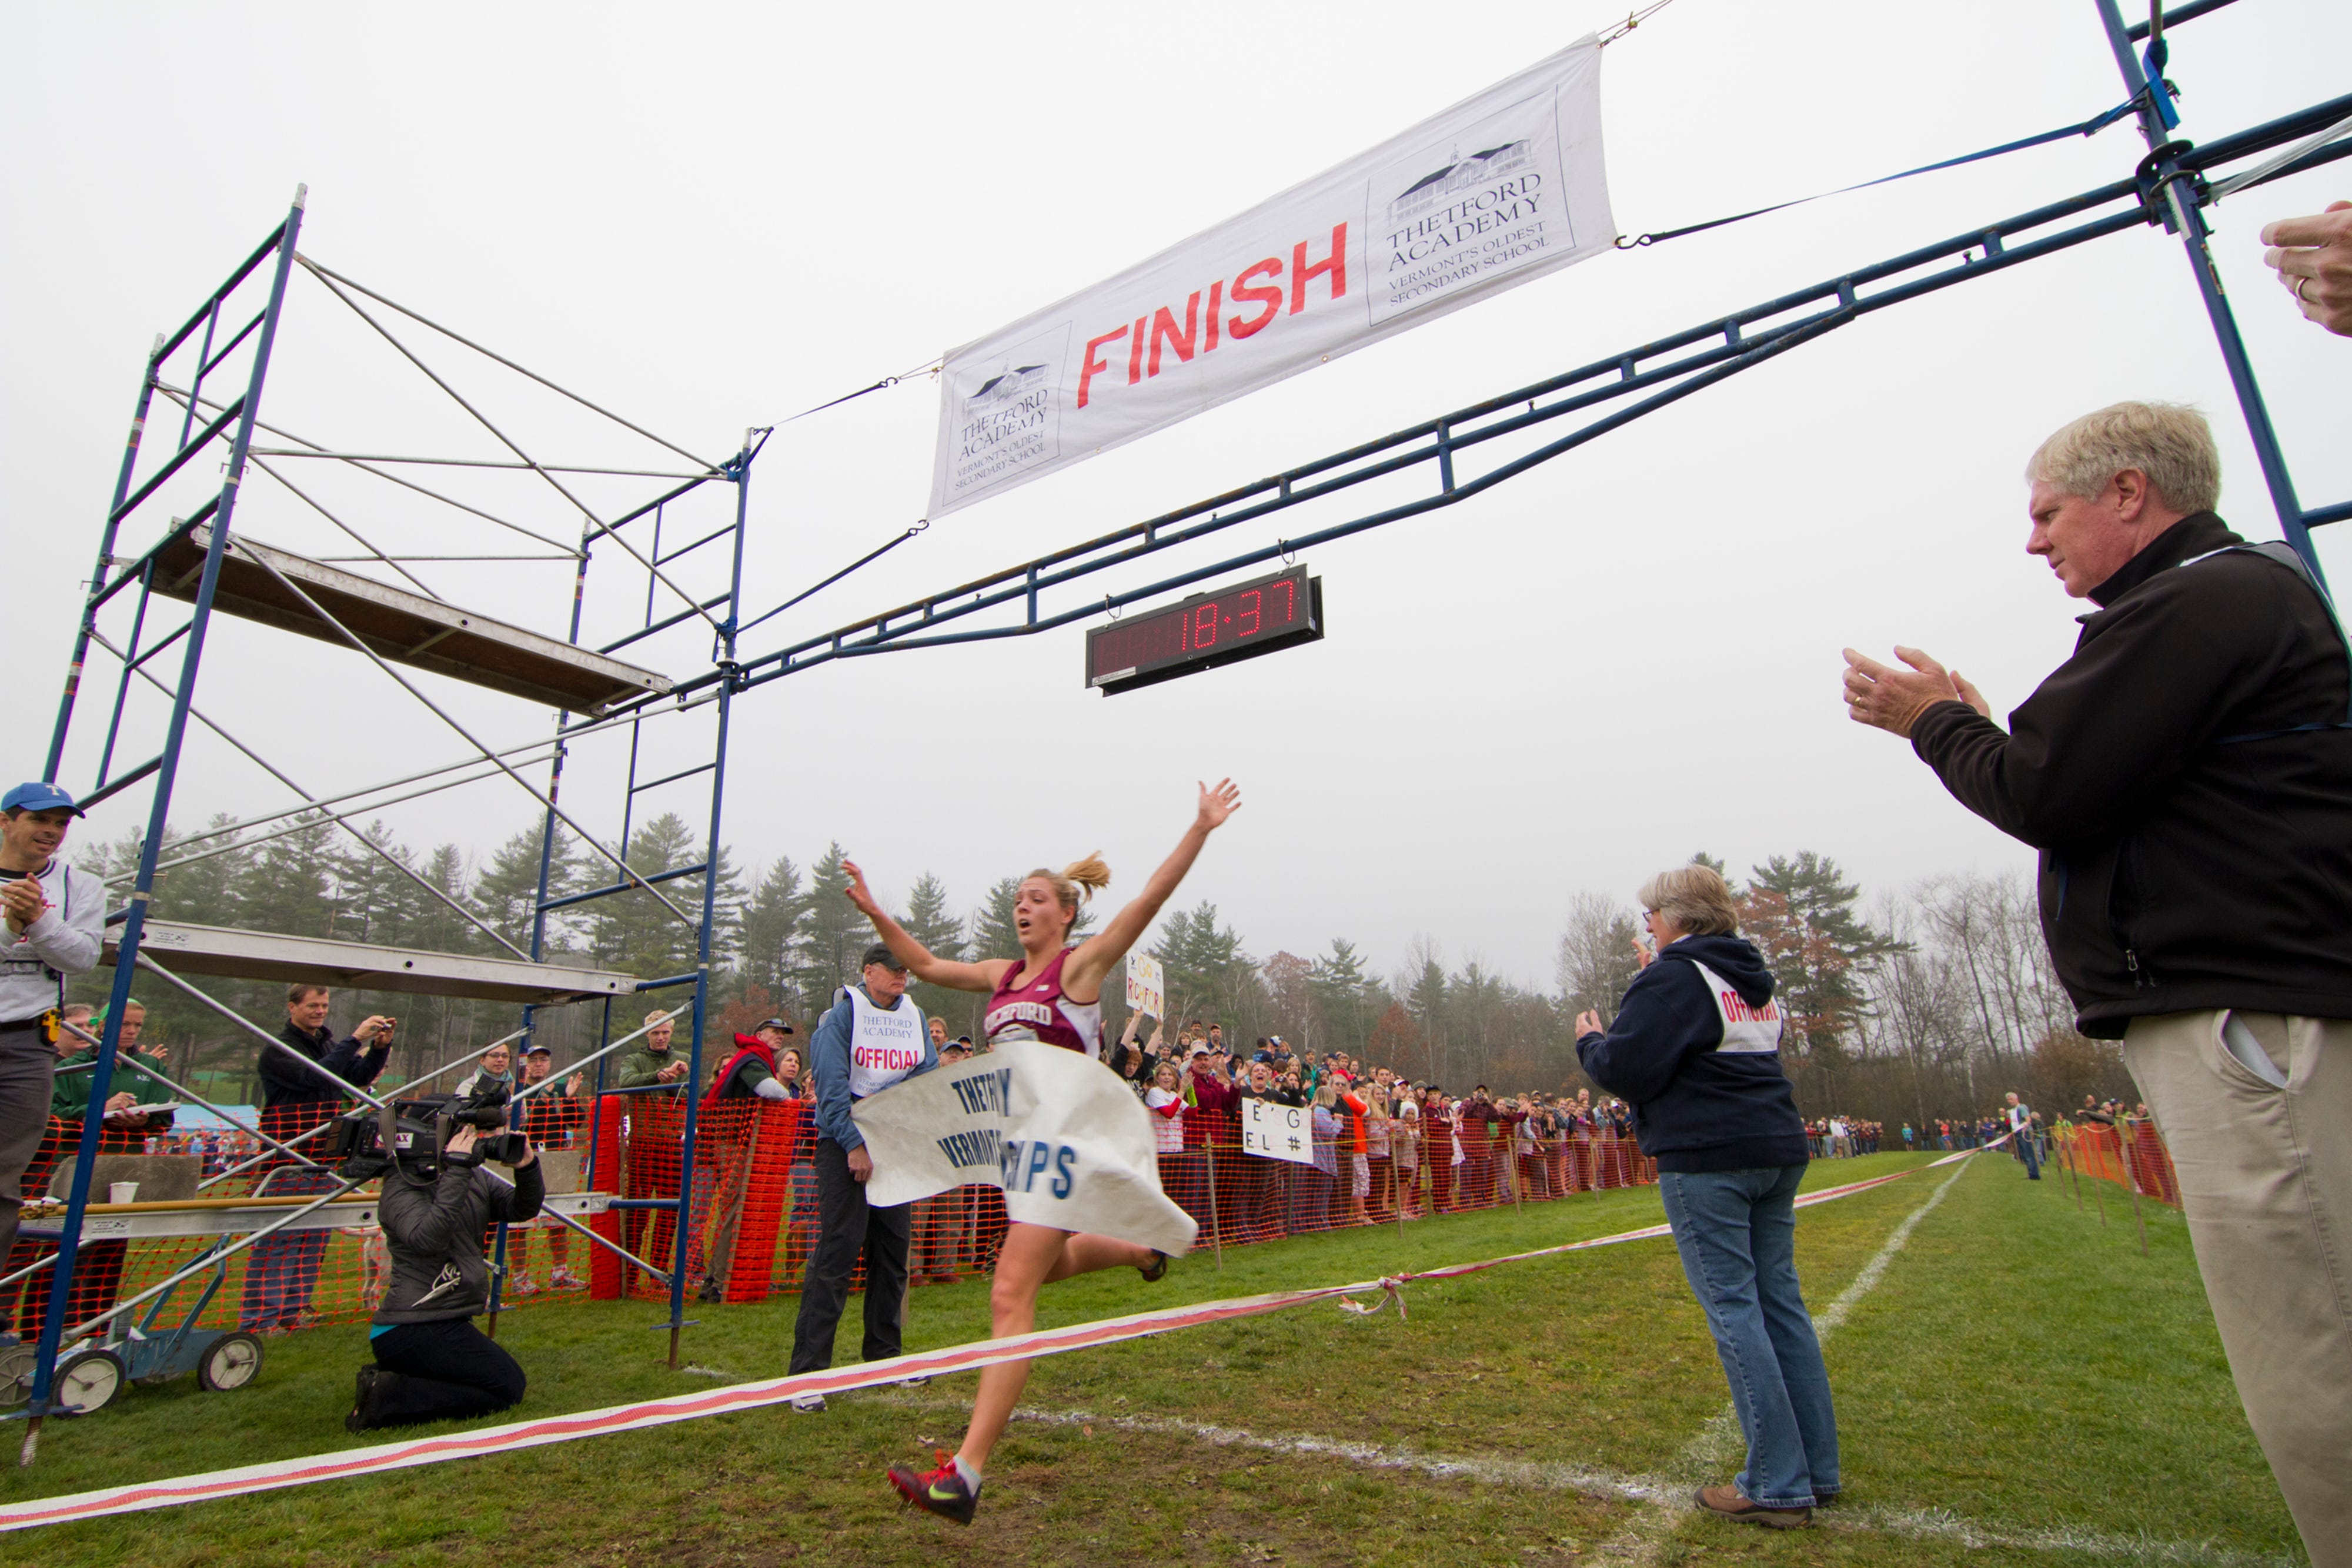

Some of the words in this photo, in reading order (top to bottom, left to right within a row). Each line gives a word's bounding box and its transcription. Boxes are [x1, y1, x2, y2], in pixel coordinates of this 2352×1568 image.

[1386, 173, 1542, 249] THETFORD
[1388, 193, 1542, 272] ACADEMY
[1389, 246, 1478, 290] VERMONT'S
[1484, 220, 1546, 253] OLDEST
[1390, 262, 1479, 306] SECONDARY
[1484, 236, 1550, 269] SCHOOL
[1077, 221, 1348, 409] FINISH
[959, 407, 1047, 461] ACADEMY
[961, 389, 1048, 442] THETFORD
[956, 460, 1007, 490] SECONDARY
[1009, 443, 1045, 466] SCHOOL
[957, 447, 1007, 477] VERMONT'S
[1009, 429, 1045, 452] OLDEST
[863, 1015, 912, 1028] THETFORD
[1128, 977, 1163, 1015] RICHFORD
[863, 1027, 912, 1038] ACADEMY
